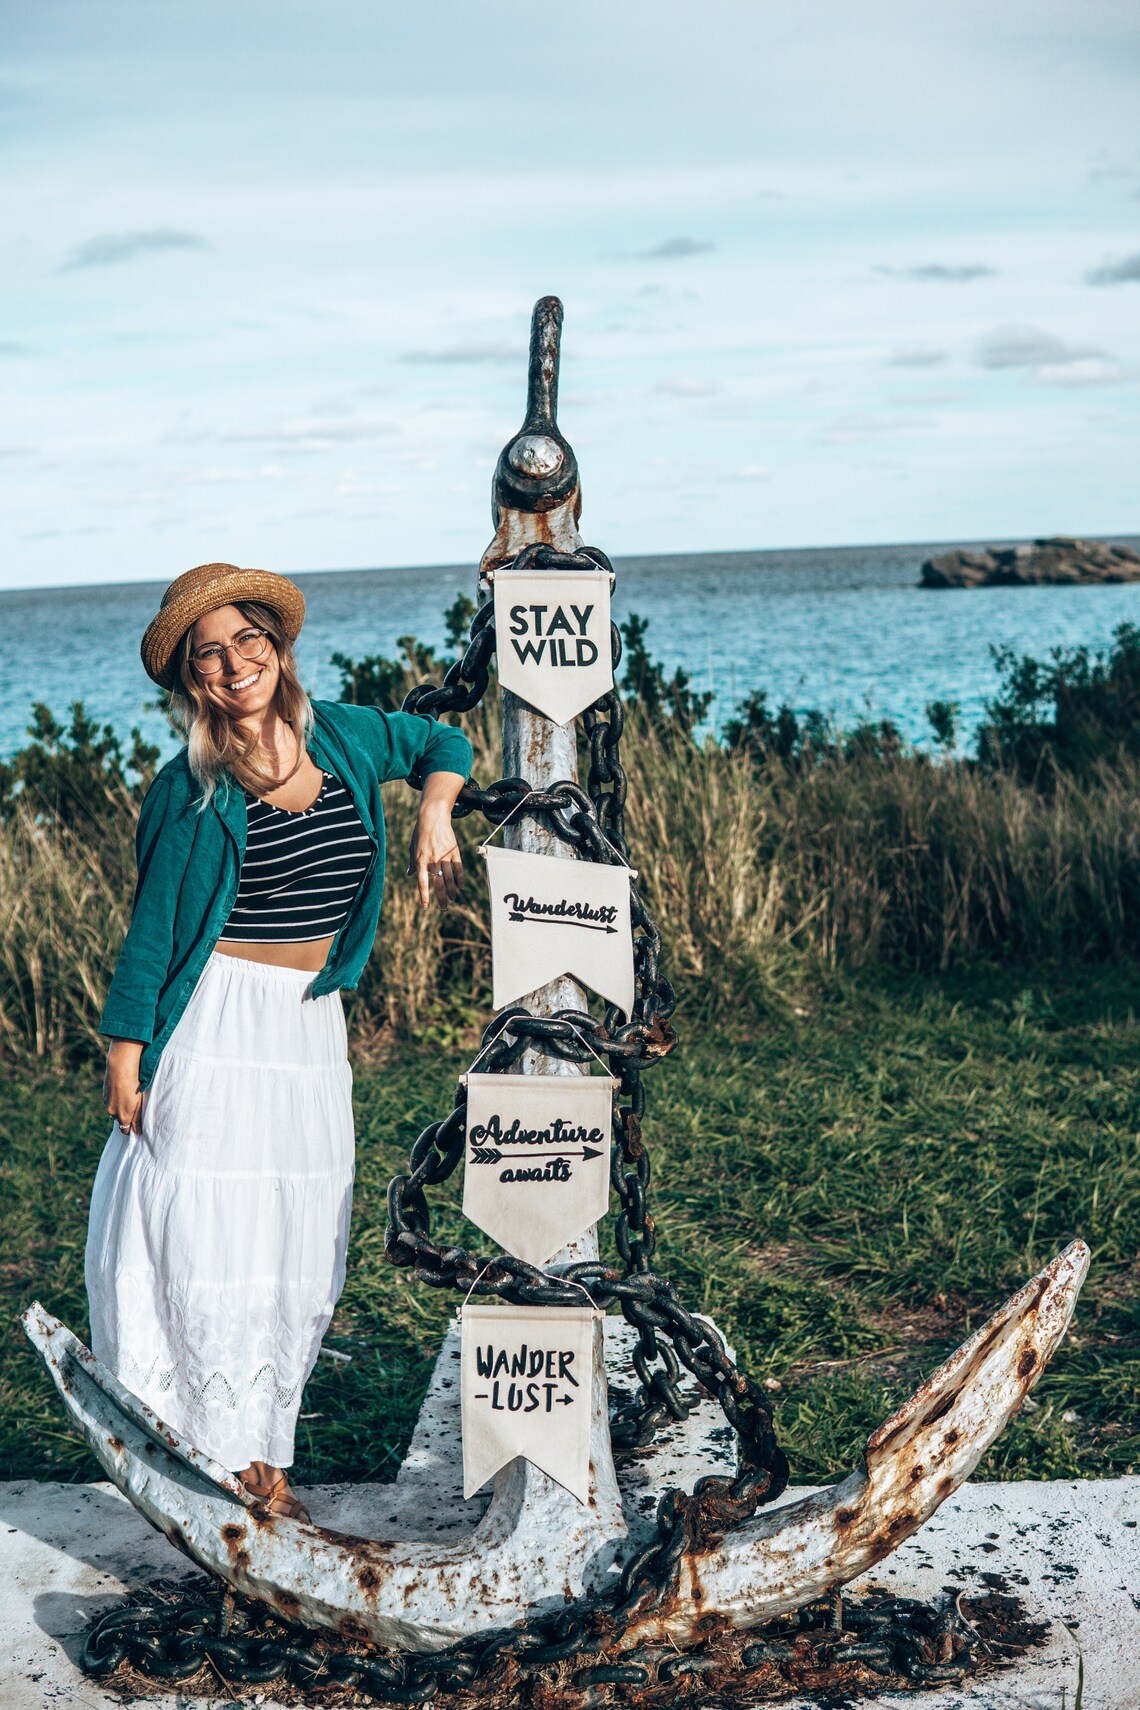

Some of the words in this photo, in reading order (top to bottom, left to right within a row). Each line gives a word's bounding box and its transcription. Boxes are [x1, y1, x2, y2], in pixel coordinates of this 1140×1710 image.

[509, 604, 595, 637] STAY
[510, 639, 599, 667] WILD
[503, 893, 619, 924] Wanderlust
[469, 1114, 604, 1147] Adventure
[499, 1157, 573, 1183] awaits
[476, 1344, 580, 1388] WANDER
